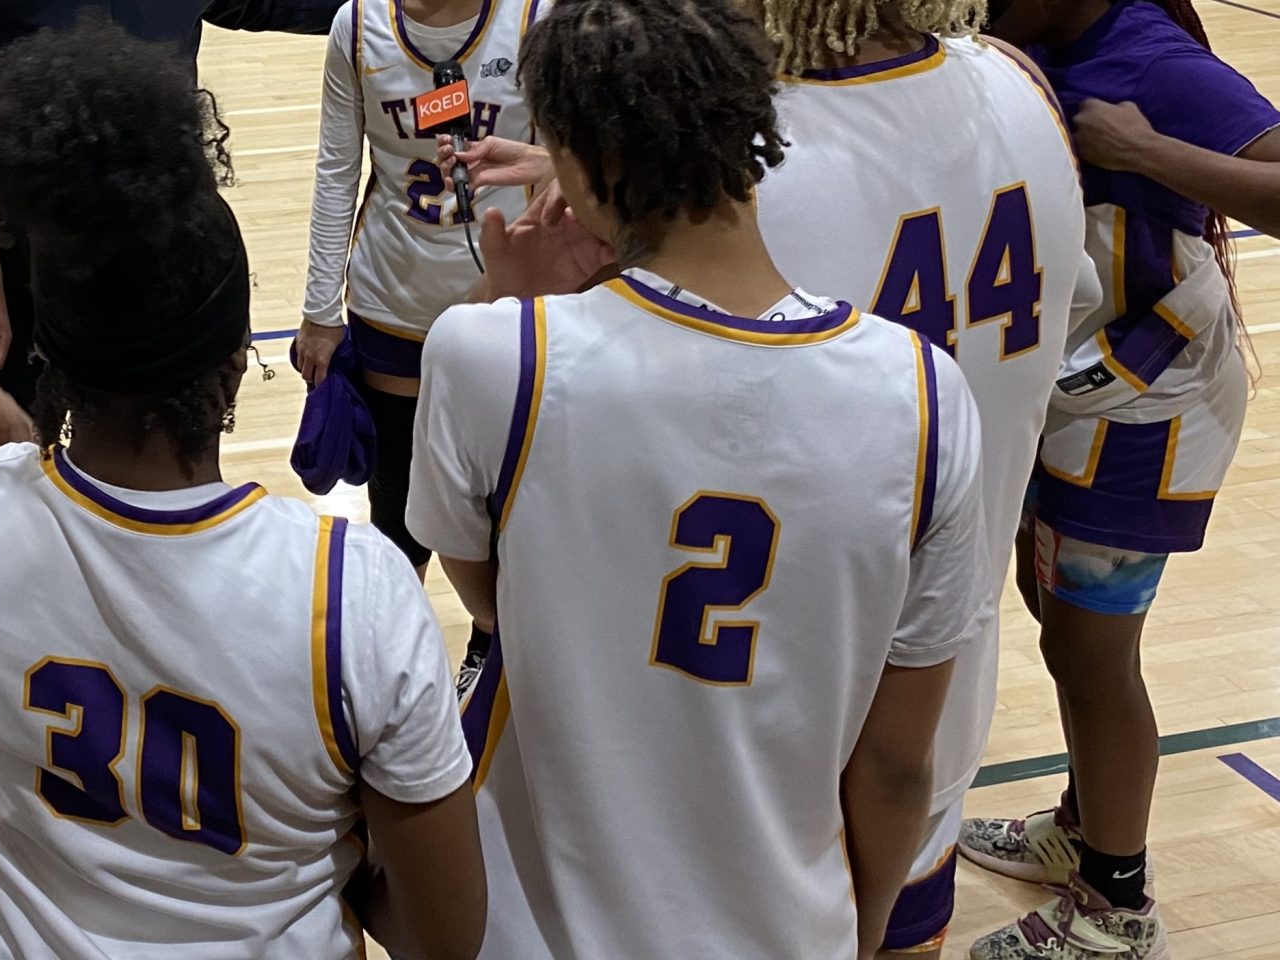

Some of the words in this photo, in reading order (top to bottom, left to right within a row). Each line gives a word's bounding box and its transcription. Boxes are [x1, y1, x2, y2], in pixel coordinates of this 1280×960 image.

[381, 99, 501, 141] TH
[420, 91, 465, 118] KQED
[868, 179, 1044, 363] 44
[1091, 371, 1106, 382] M
[649, 490, 782, 687] 2
[22, 655, 249, 858] 30
